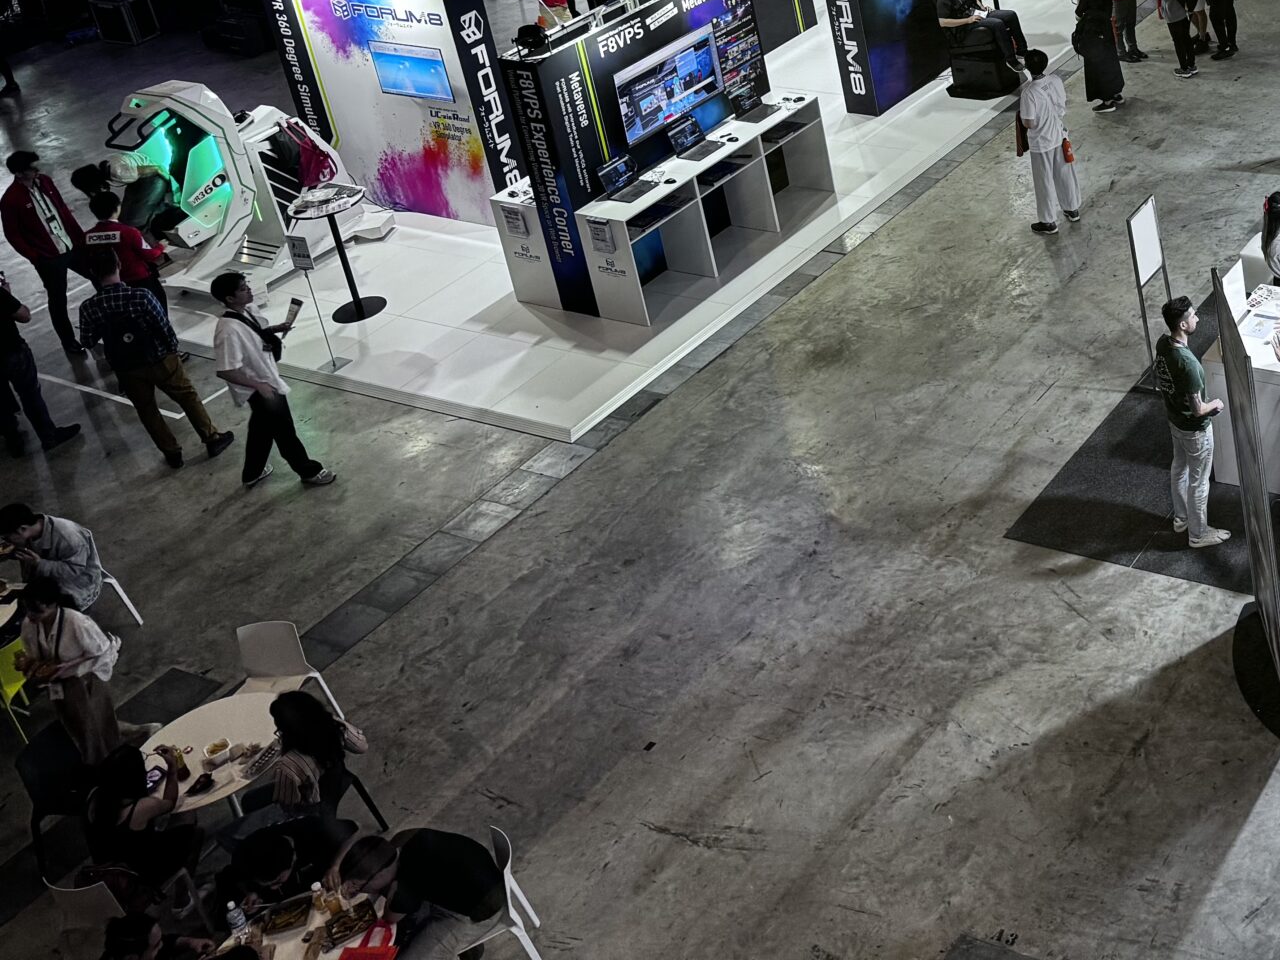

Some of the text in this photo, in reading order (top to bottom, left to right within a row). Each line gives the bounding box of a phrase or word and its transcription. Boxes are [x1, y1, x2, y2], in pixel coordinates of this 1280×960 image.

[274, 11, 292, 36] 360
[350, 3, 443, 27] FORUM8
[599, 24, 644, 58] F8VPS
[280, 36, 307, 81] Degree
[471, 42, 522, 188] FORUM8
[567, 71, 593, 128] Metaverse
[432, 121, 441, 130] VR
[516, 67, 578, 258] F8VPS Experience Corner
[192, 173, 227, 204] VR360
